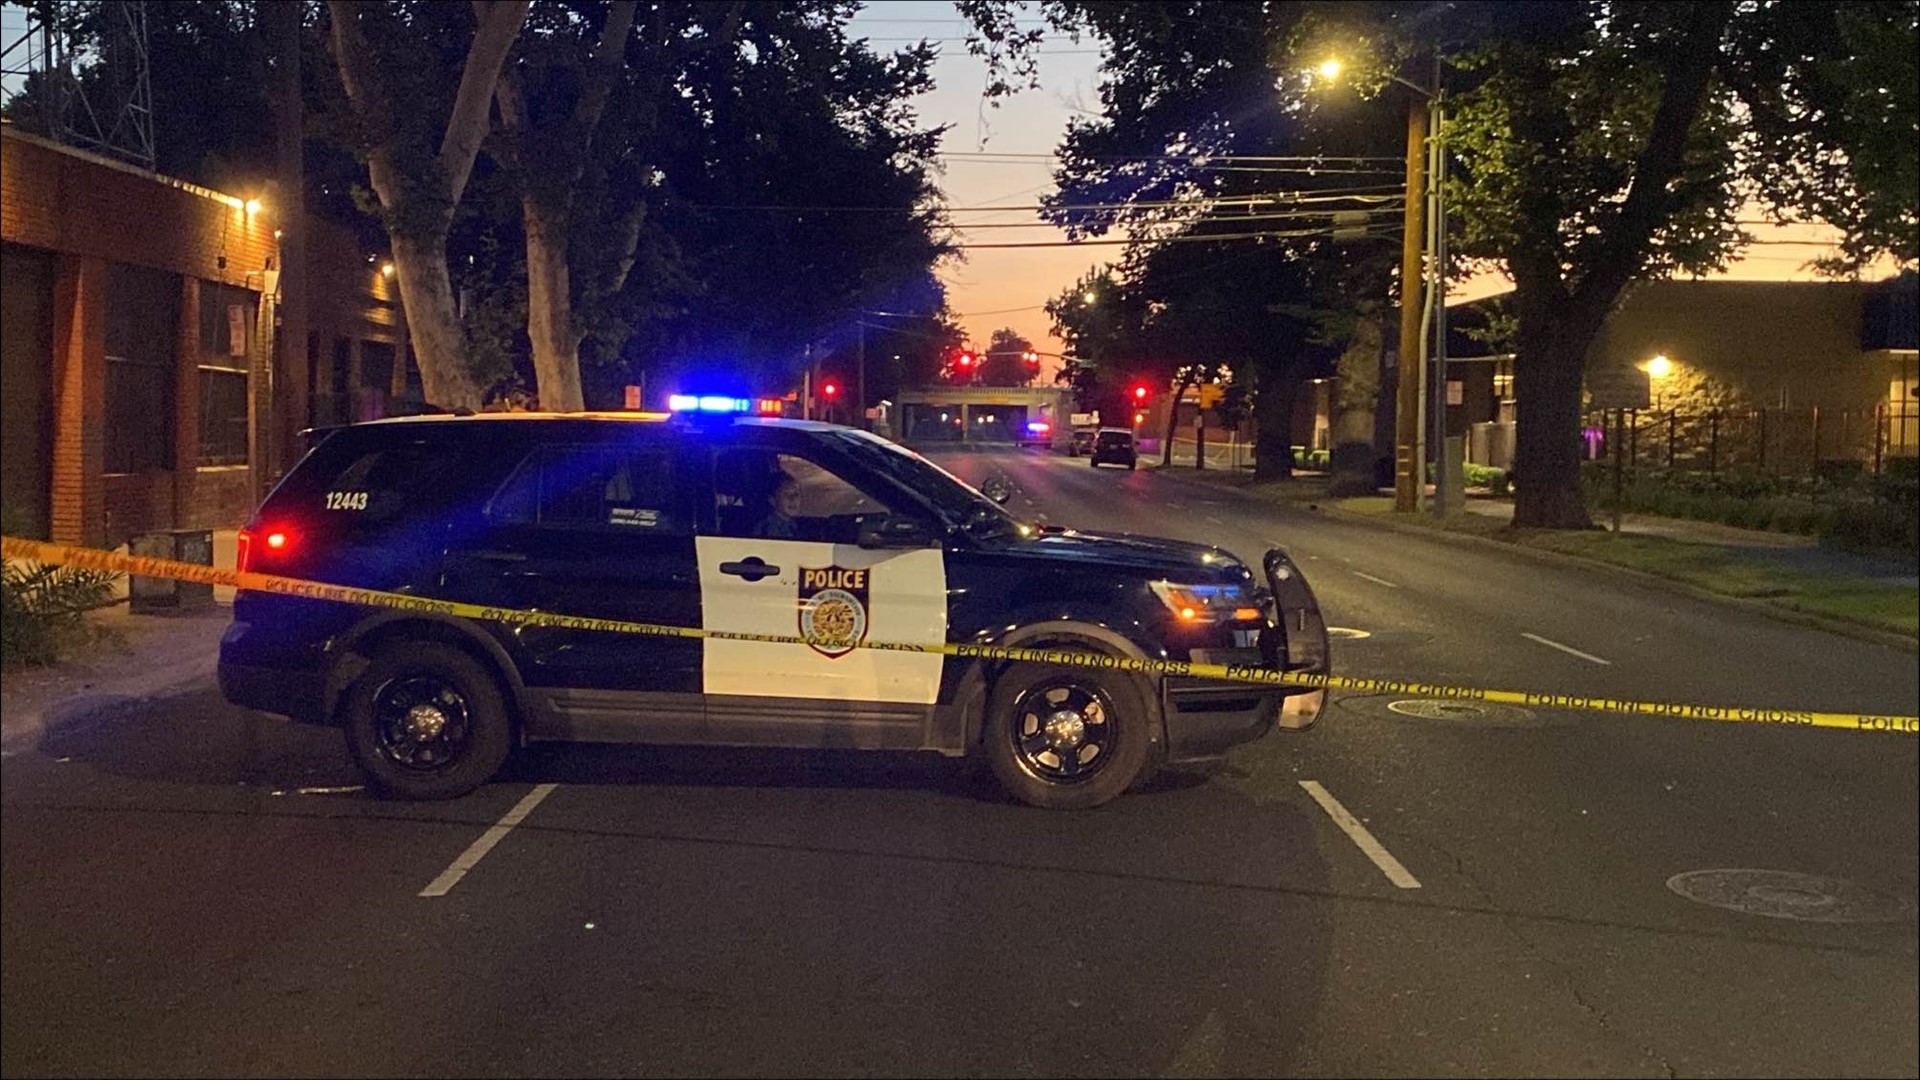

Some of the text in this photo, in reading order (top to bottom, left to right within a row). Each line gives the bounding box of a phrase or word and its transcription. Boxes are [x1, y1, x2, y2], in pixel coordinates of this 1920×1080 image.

[326, 491, 368, 510] 12443
[804, 570, 864, 588] POLICE
[266, 580, 316, 596] POLICE
[405, 599, 455, 614] CROSS
[481, 608, 534, 622] POLICE
[957, 645, 1190, 674] POLICE LINE DO NOT CROSS
[1226, 666, 1484, 698] POLICE LINE DO NOT CROSS
[1526, 693, 1812, 725] POLICE LINE DO NOT CROSS
